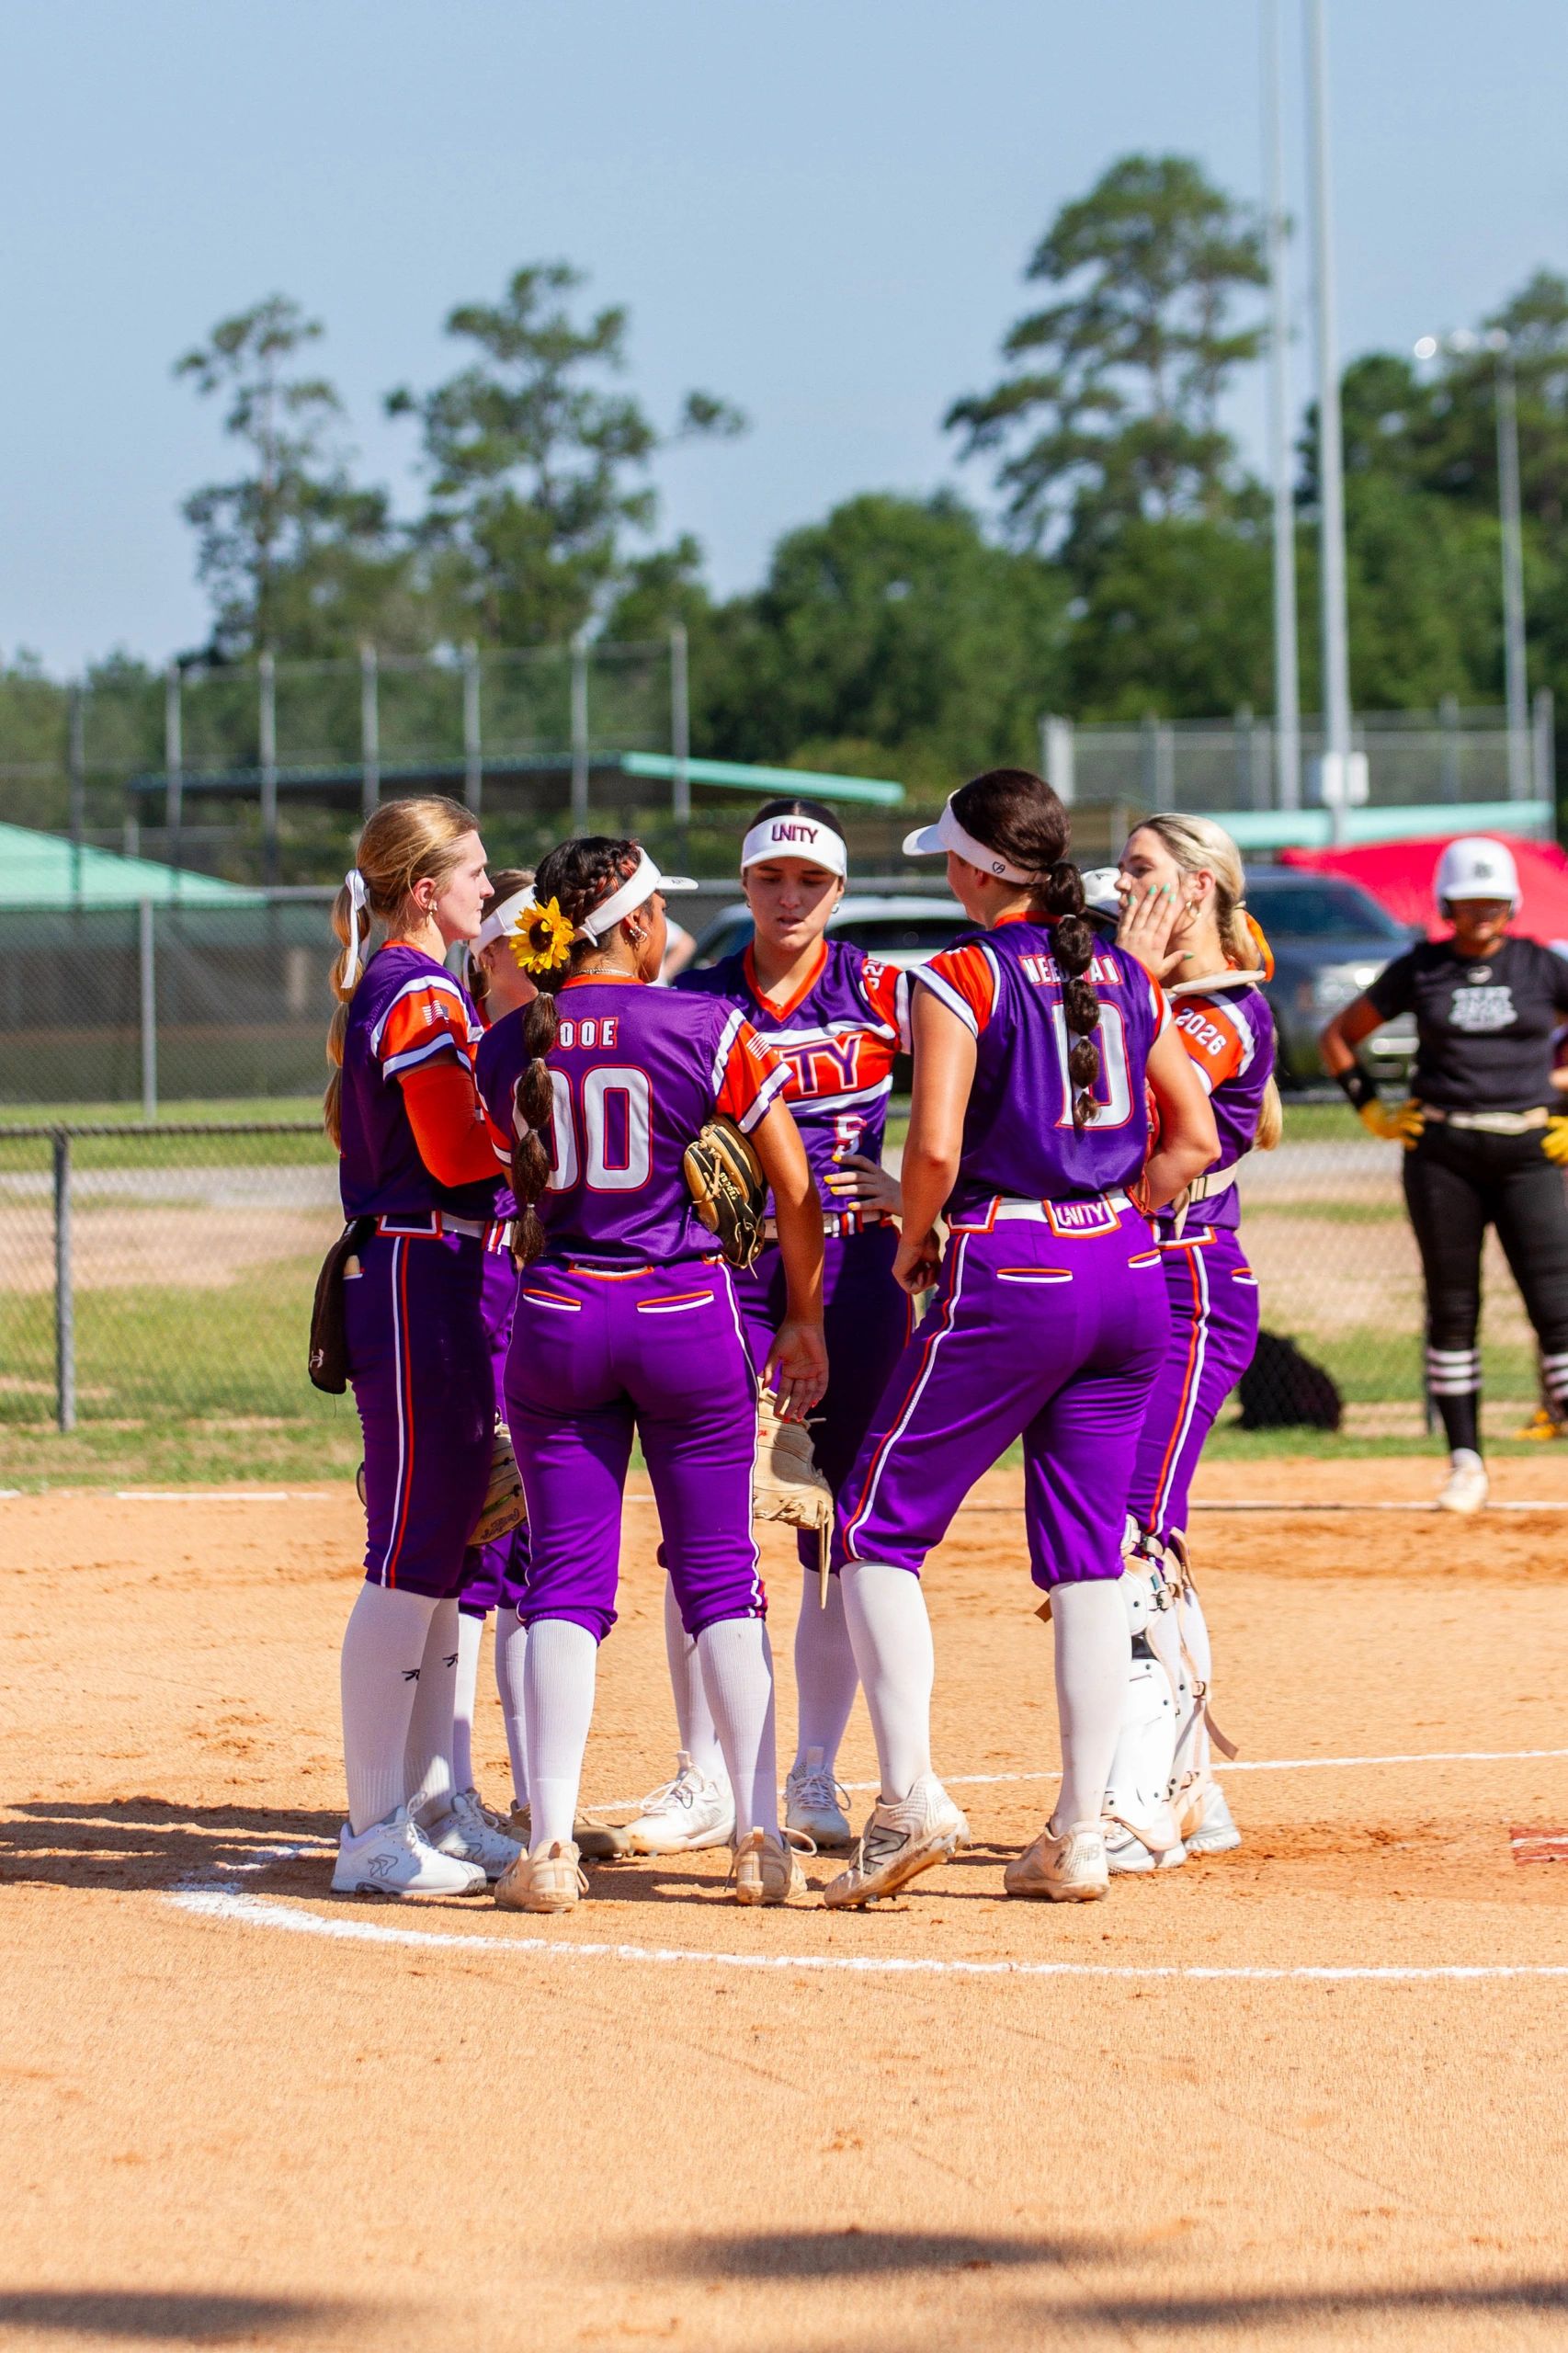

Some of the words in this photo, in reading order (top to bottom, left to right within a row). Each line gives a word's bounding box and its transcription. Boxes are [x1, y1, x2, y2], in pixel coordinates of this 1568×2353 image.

[771, 823, 818, 844] UNITY
[1174, 1007, 1227, 1056] 2026
[1055, 1202, 1105, 1227] UNITY
